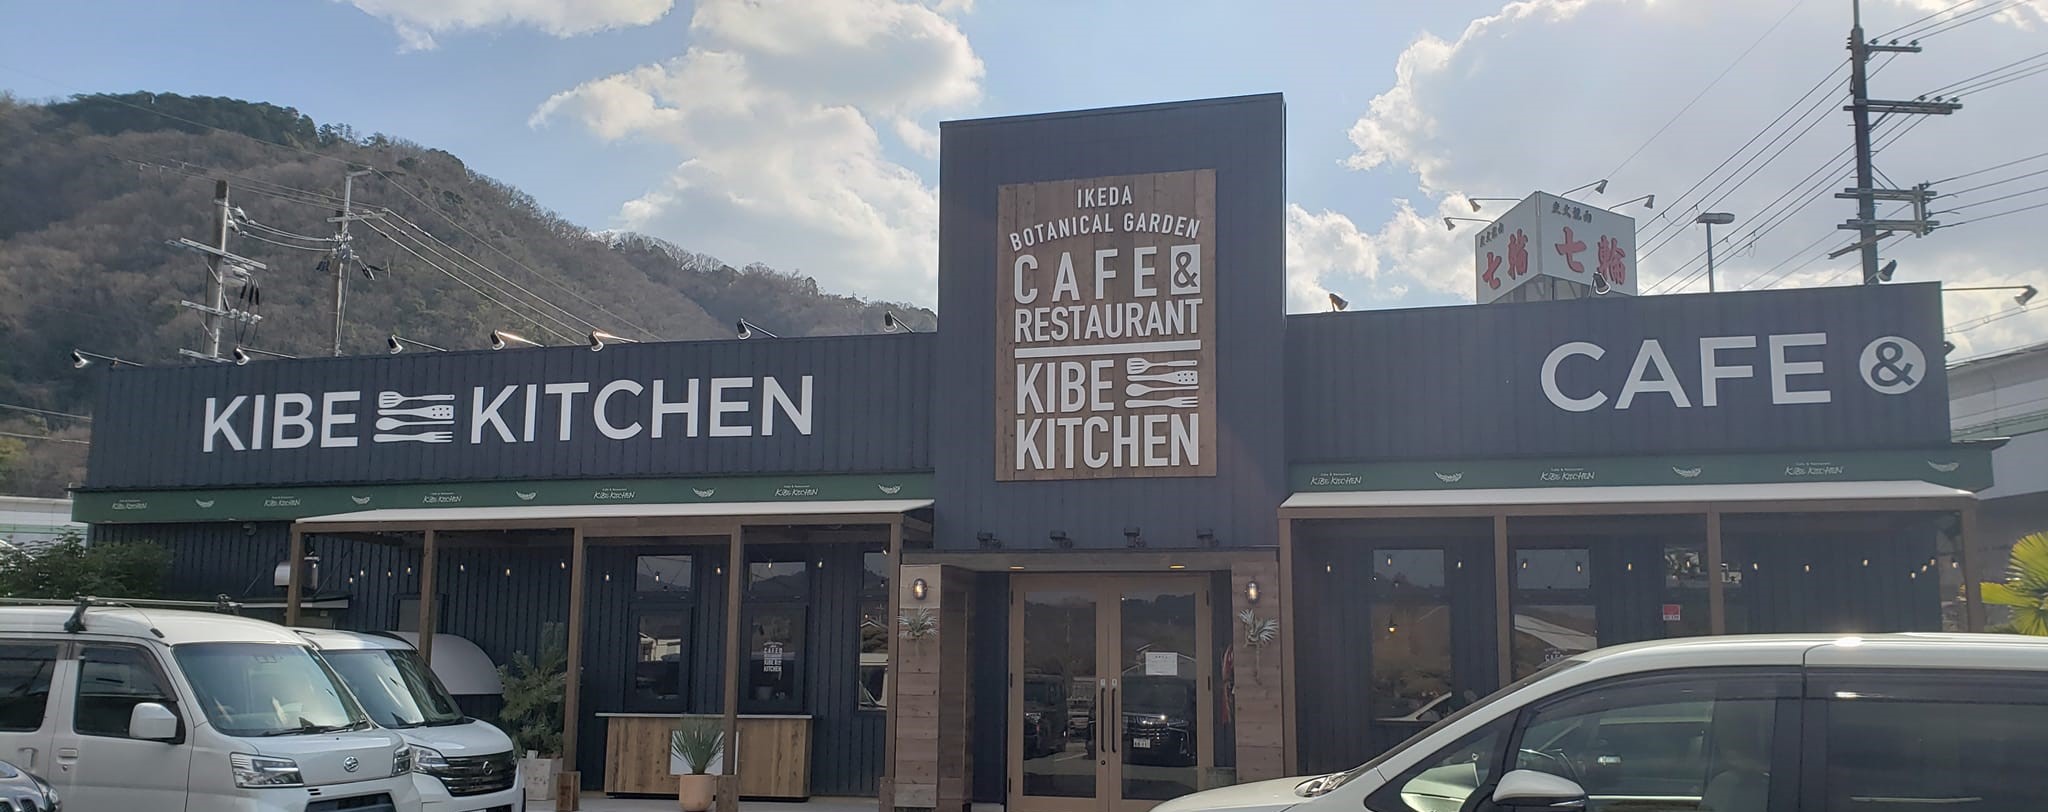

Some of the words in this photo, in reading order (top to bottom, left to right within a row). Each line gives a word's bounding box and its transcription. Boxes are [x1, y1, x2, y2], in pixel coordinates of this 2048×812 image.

[1077, 185, 1133, 208] IKEDA
[1010, 213, 1114, 251] BOTANICAL
[1123, 212, 1200, 239] GARDEN
[1555, 226, 1626, 285] 七輪
[1014, 246, 1157, 304] CAFE
[1014, 298, 1203, 343] RESTAURANT
[1016, 360, 1114, 414] KIBE
[1540, 332, 1832, 412] CAFE
[1865, 338, 1921, 390] &
[202, 390, 361, 453] KIBE
[470, 375, 813, 445] KITCHEN
[1016, 413, 1199, 470] KITCHEN
